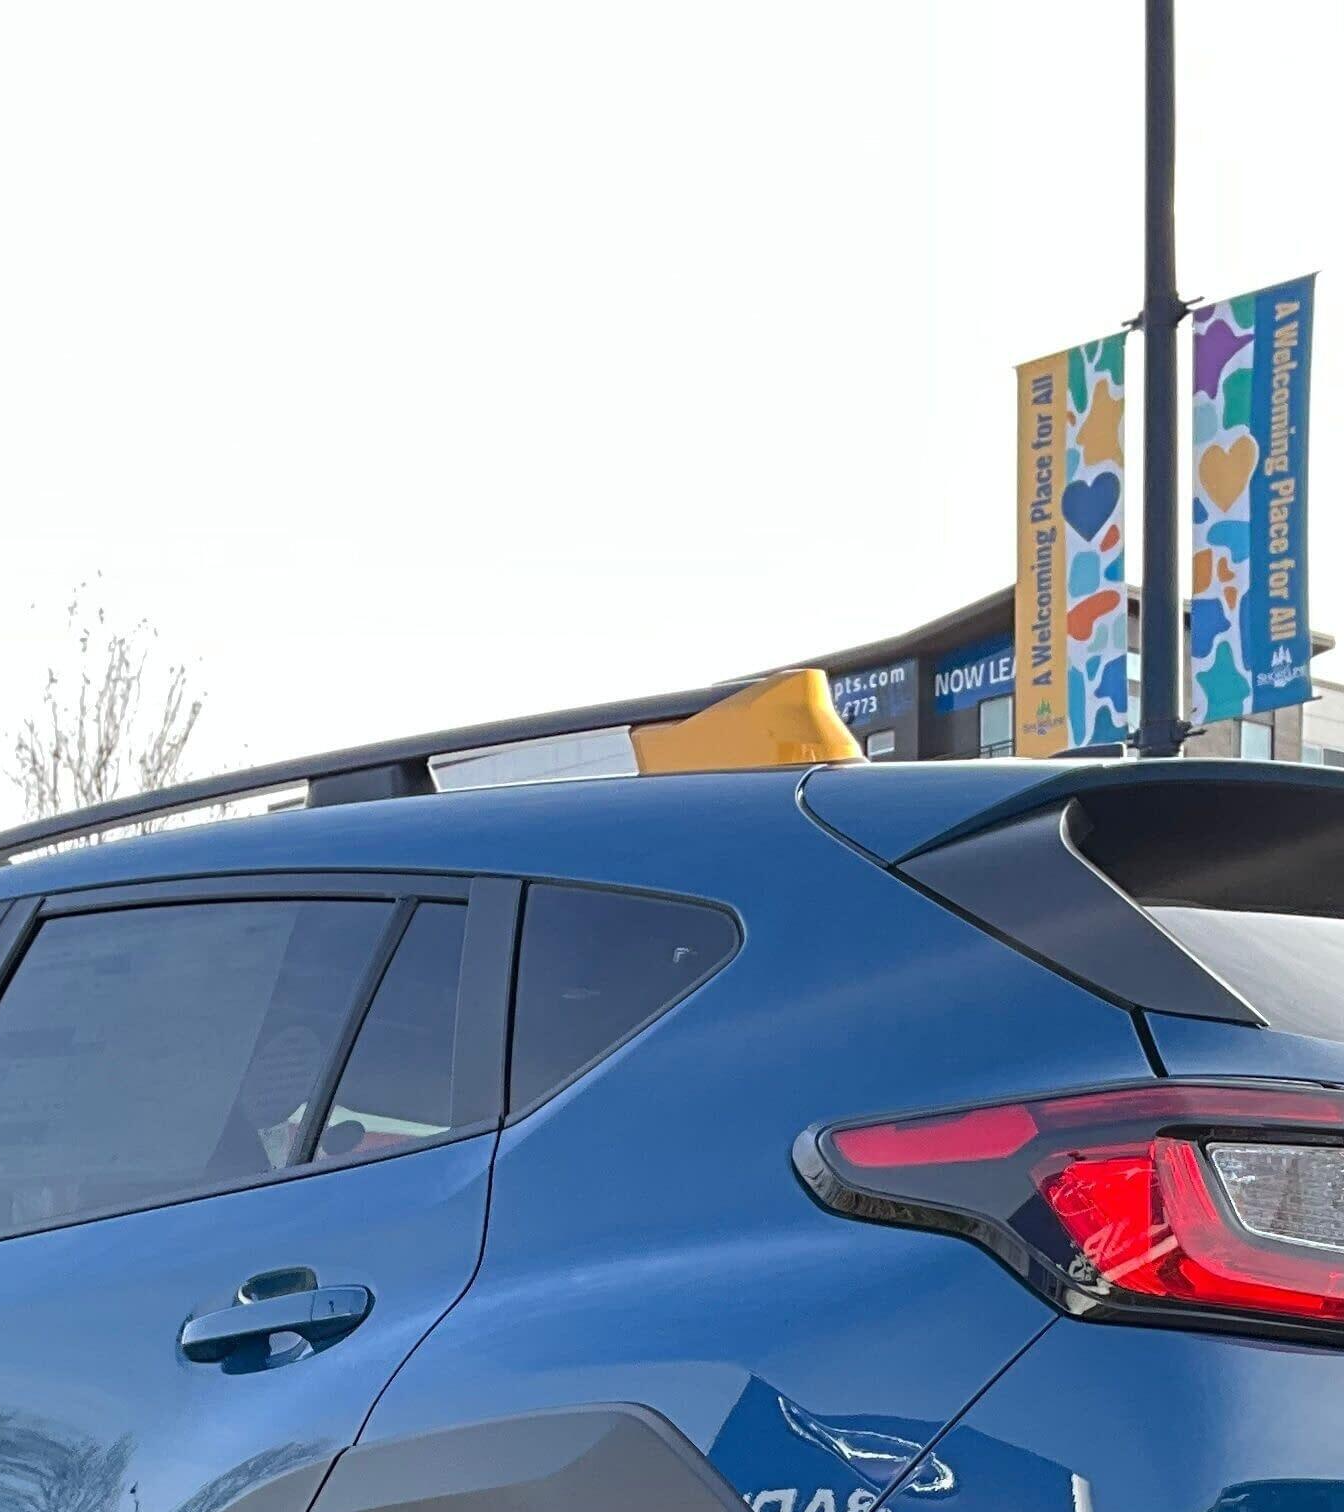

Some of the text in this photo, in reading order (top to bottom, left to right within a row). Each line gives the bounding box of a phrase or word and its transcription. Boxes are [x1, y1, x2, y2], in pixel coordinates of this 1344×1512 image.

[1273, 301, 1300, 321] A
[1264, 320, 1299, 476] Welcoming
[1030, 374, 1057, 686] A Welcoming Place for All
[1269, 477, 1295, 554] Place
[1269, 558, 1296, 600] for
[1269, 607, 1297, 641] All
[833, 667, 905, 702] pts.com
[935, 663, 984, 697] NOW
